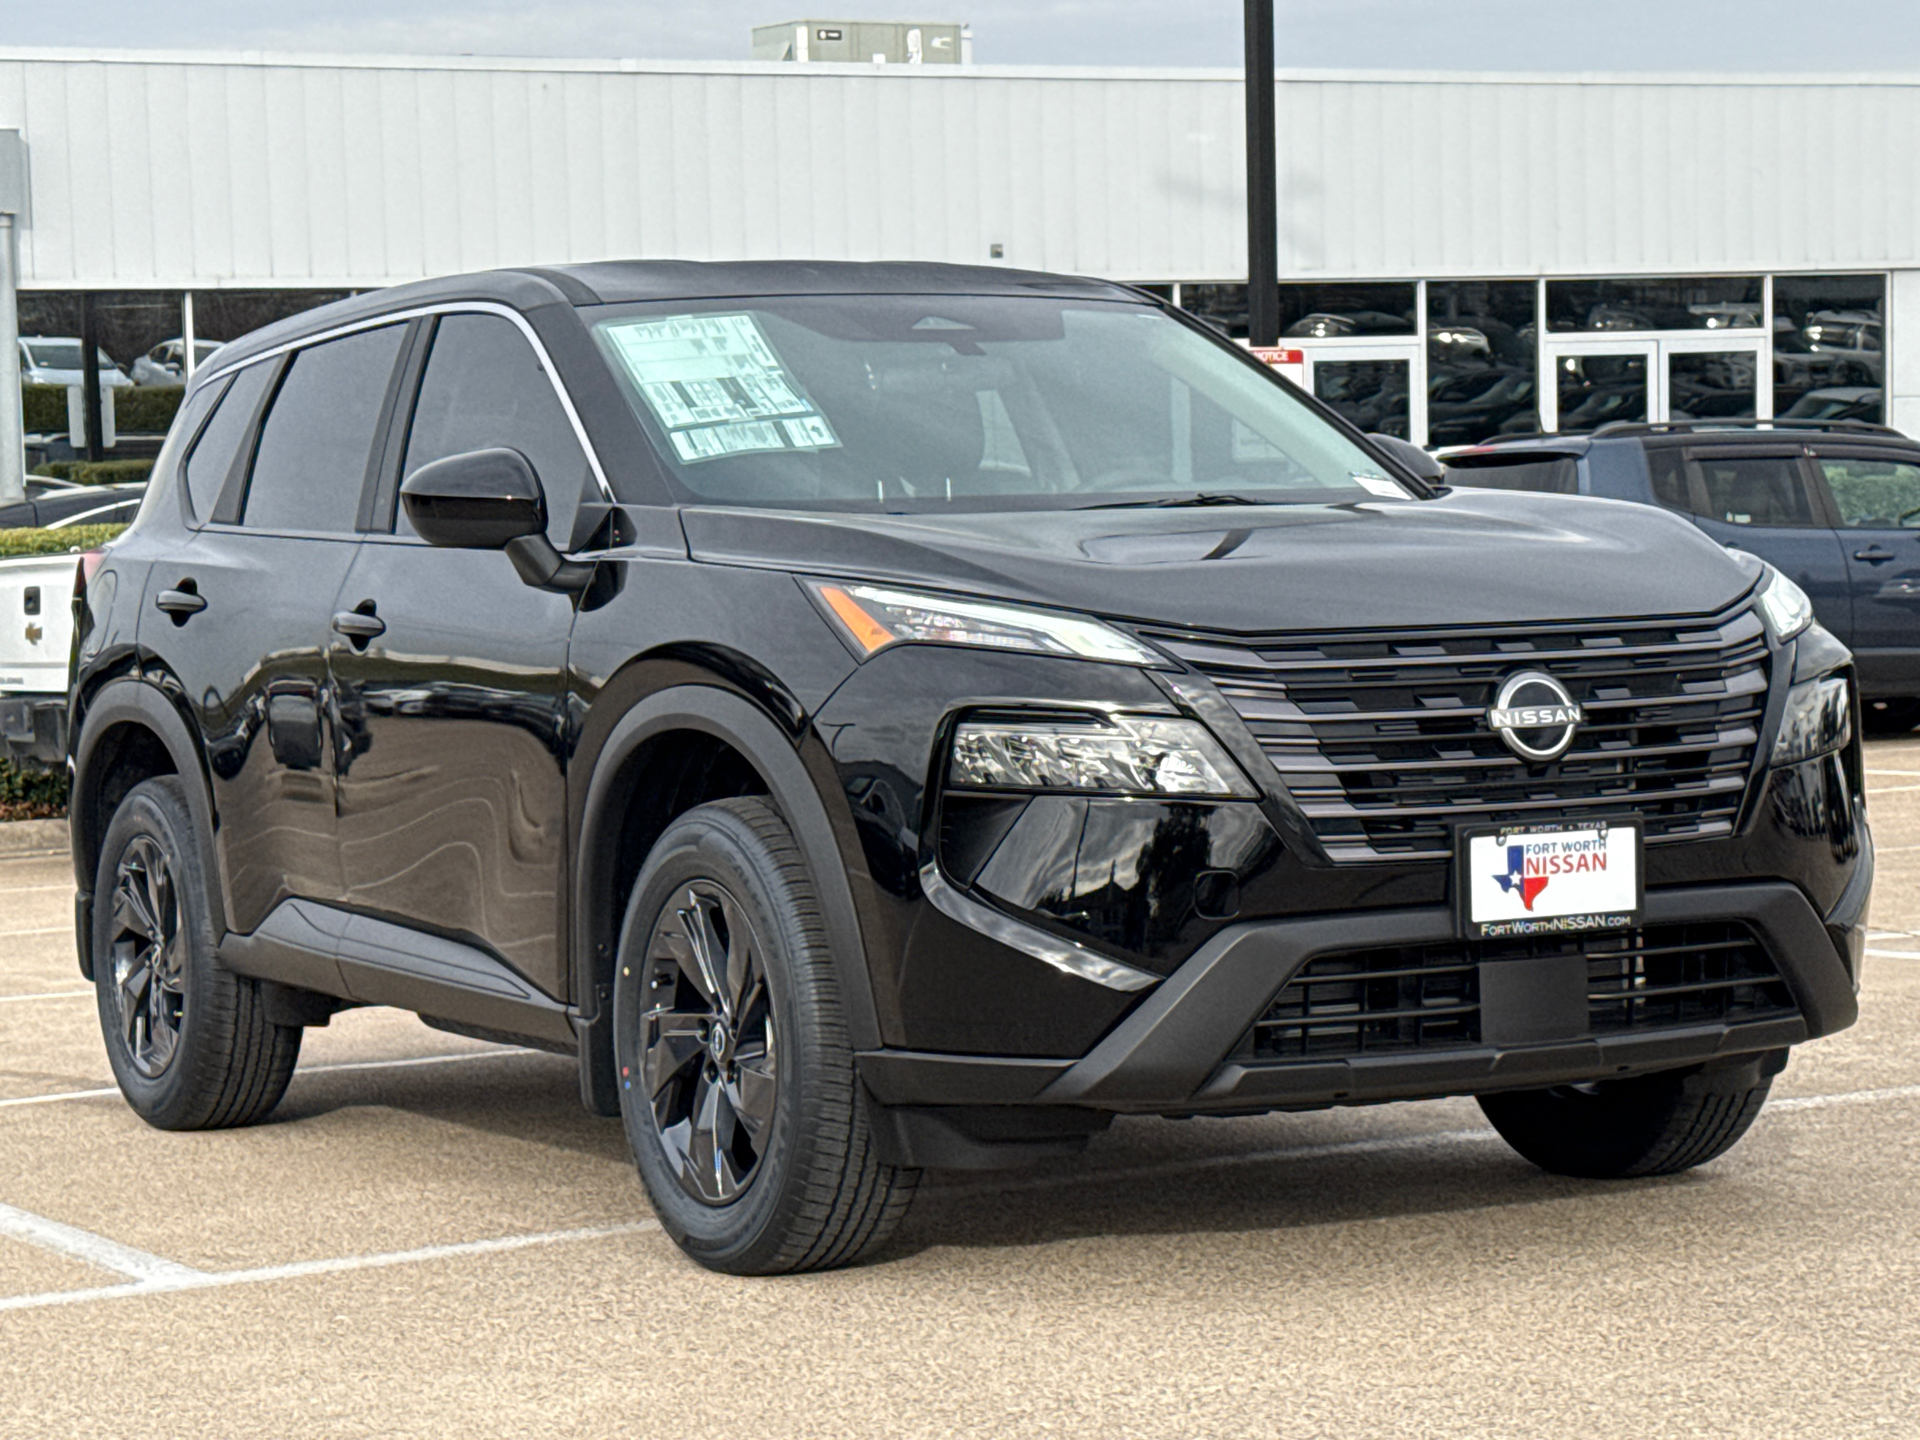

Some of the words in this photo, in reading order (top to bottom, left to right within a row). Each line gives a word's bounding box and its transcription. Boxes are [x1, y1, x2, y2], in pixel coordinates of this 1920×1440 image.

[1491, 707, 1581, 728] NISSAN
[1500, 826, 1525, 835] FORT
[1530, 824, 1563, 833] WORTH
[1577, 820, 1607, 830] TEXAS
[1526, 842, 1558, 855] FORT
[1561, 839, 1607, 853] WORTH
[1526, 852, 1607, 876] NISSAN
